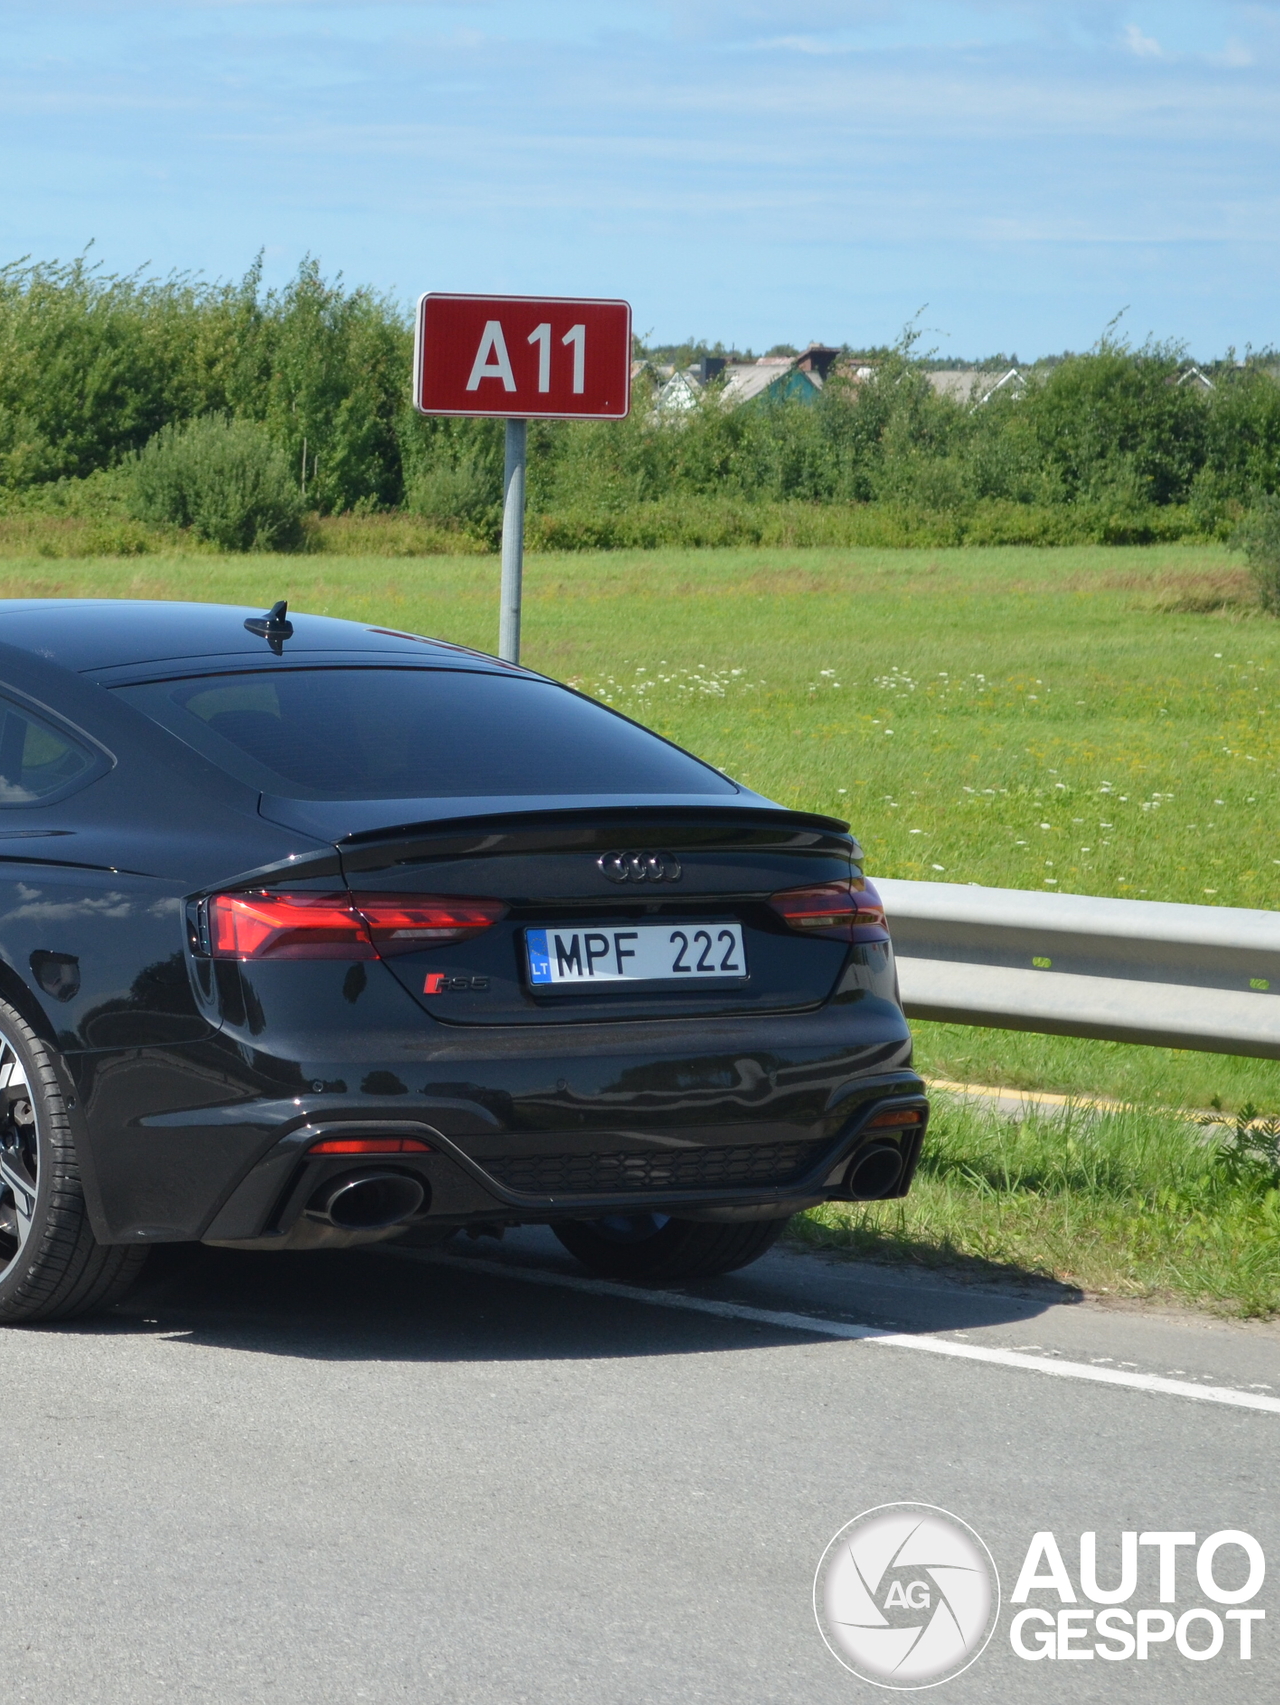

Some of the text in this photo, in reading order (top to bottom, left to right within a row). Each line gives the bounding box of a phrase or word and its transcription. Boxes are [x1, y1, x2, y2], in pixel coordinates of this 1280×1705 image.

[465, 320, 586, 394] A11
[532, 930, 740, 977] LT MPF 222
